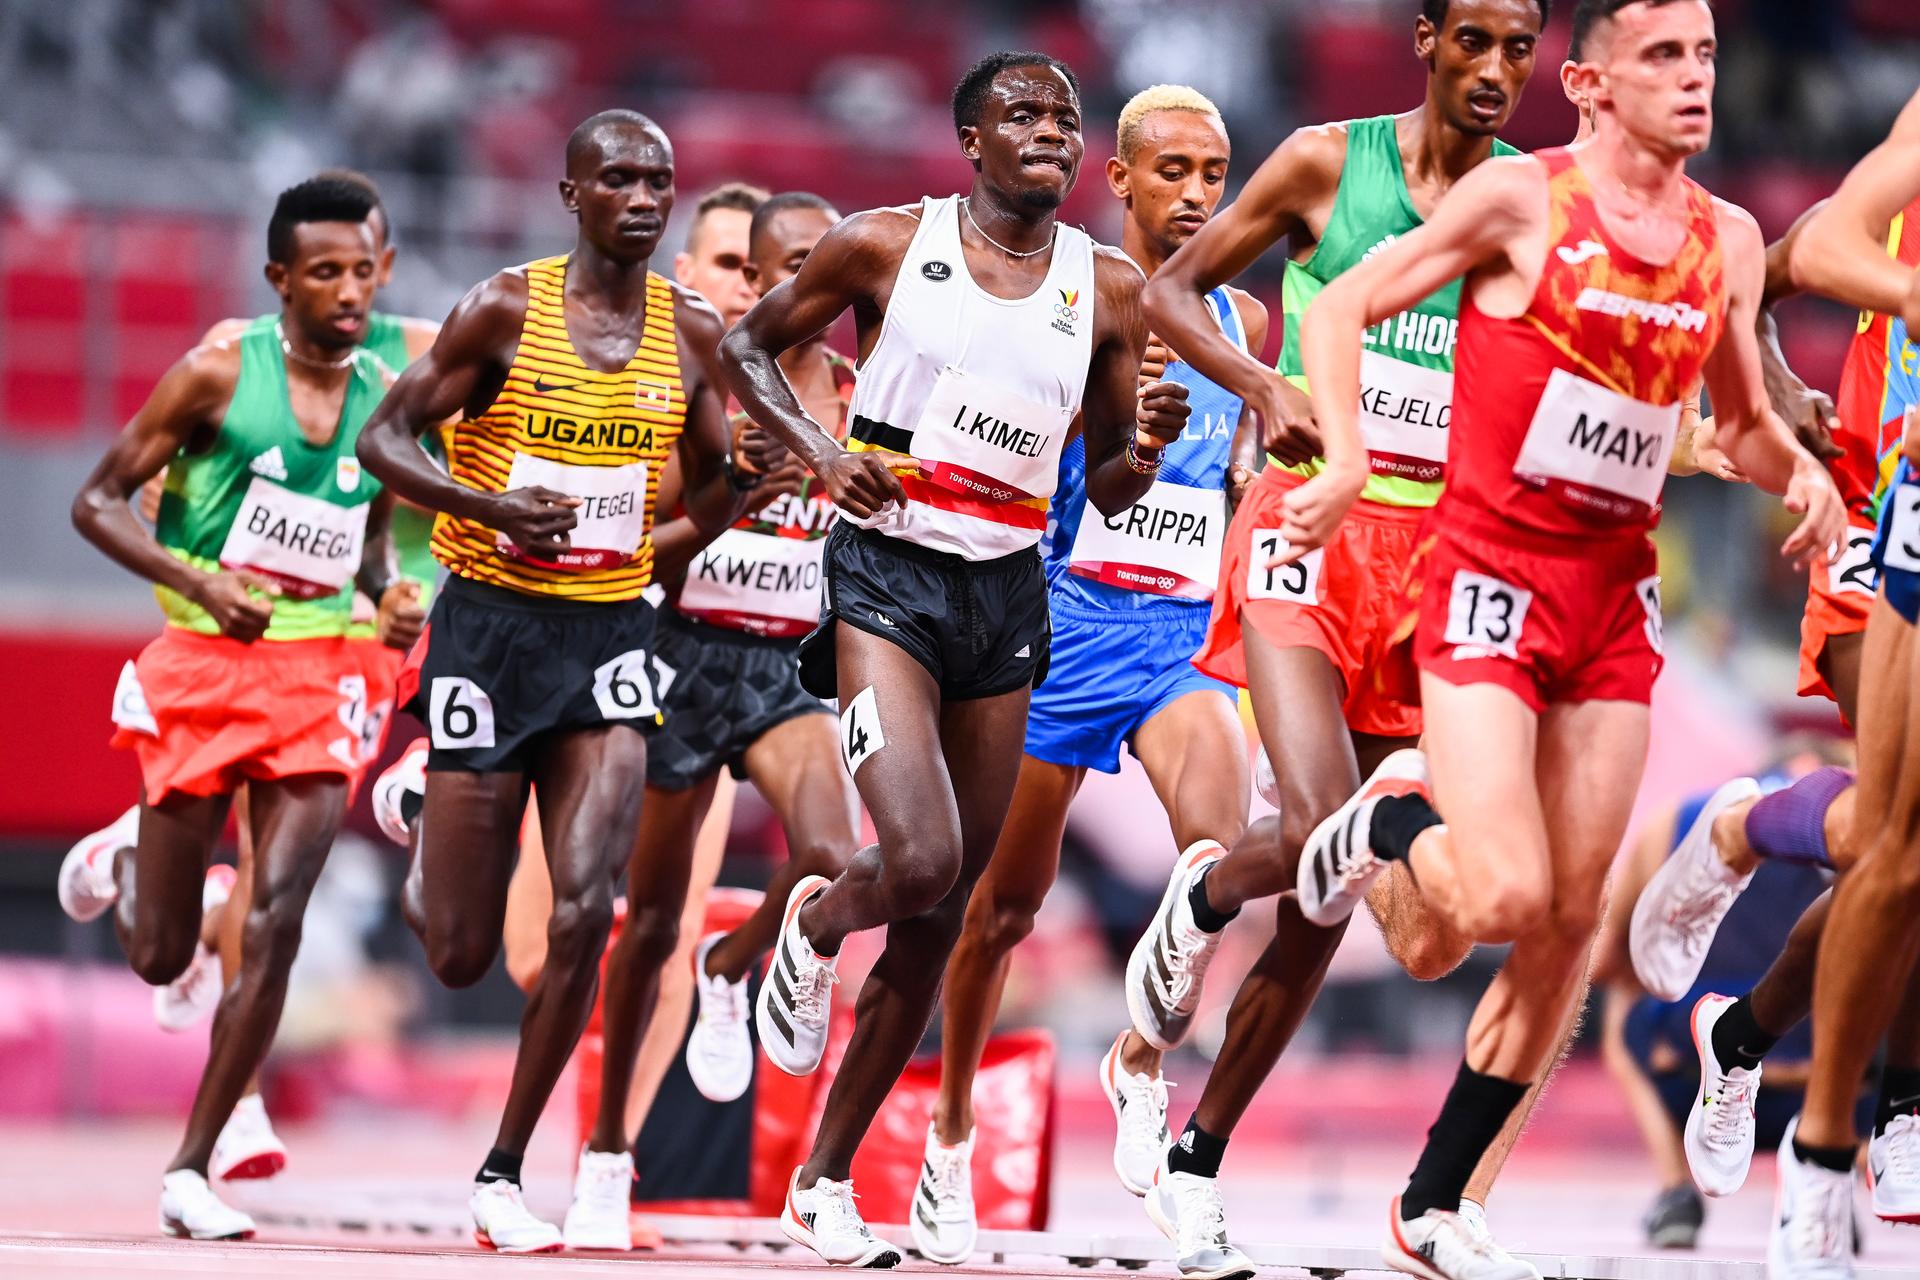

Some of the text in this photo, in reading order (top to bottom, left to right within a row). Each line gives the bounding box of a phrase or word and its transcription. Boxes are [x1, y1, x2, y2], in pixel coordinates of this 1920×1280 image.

[1051, 321, 1075, 337] BELGIUM
[1056, 318, 1072, 330] TEAM
[527, 414, 653, 451] UGANDA
[953, 404, 1050, 458] I.KIMELI
[1177, 413, 1229, 441] LIA
[949, 472, 991, 494] TOKYO 2020
[584, 491, 634, 519] TEGEI
[749, 493, 840, 530] ENY
[699, 550, 819, 593] KWEMO
[1117, 570, 1156, 585] TOKYO 2020
[1464, 585, 1515, 643] 13
[610, 664, 642, 709] 6
[442, 686, 477, 739] 6
[848, 705, 869, 760] 4
